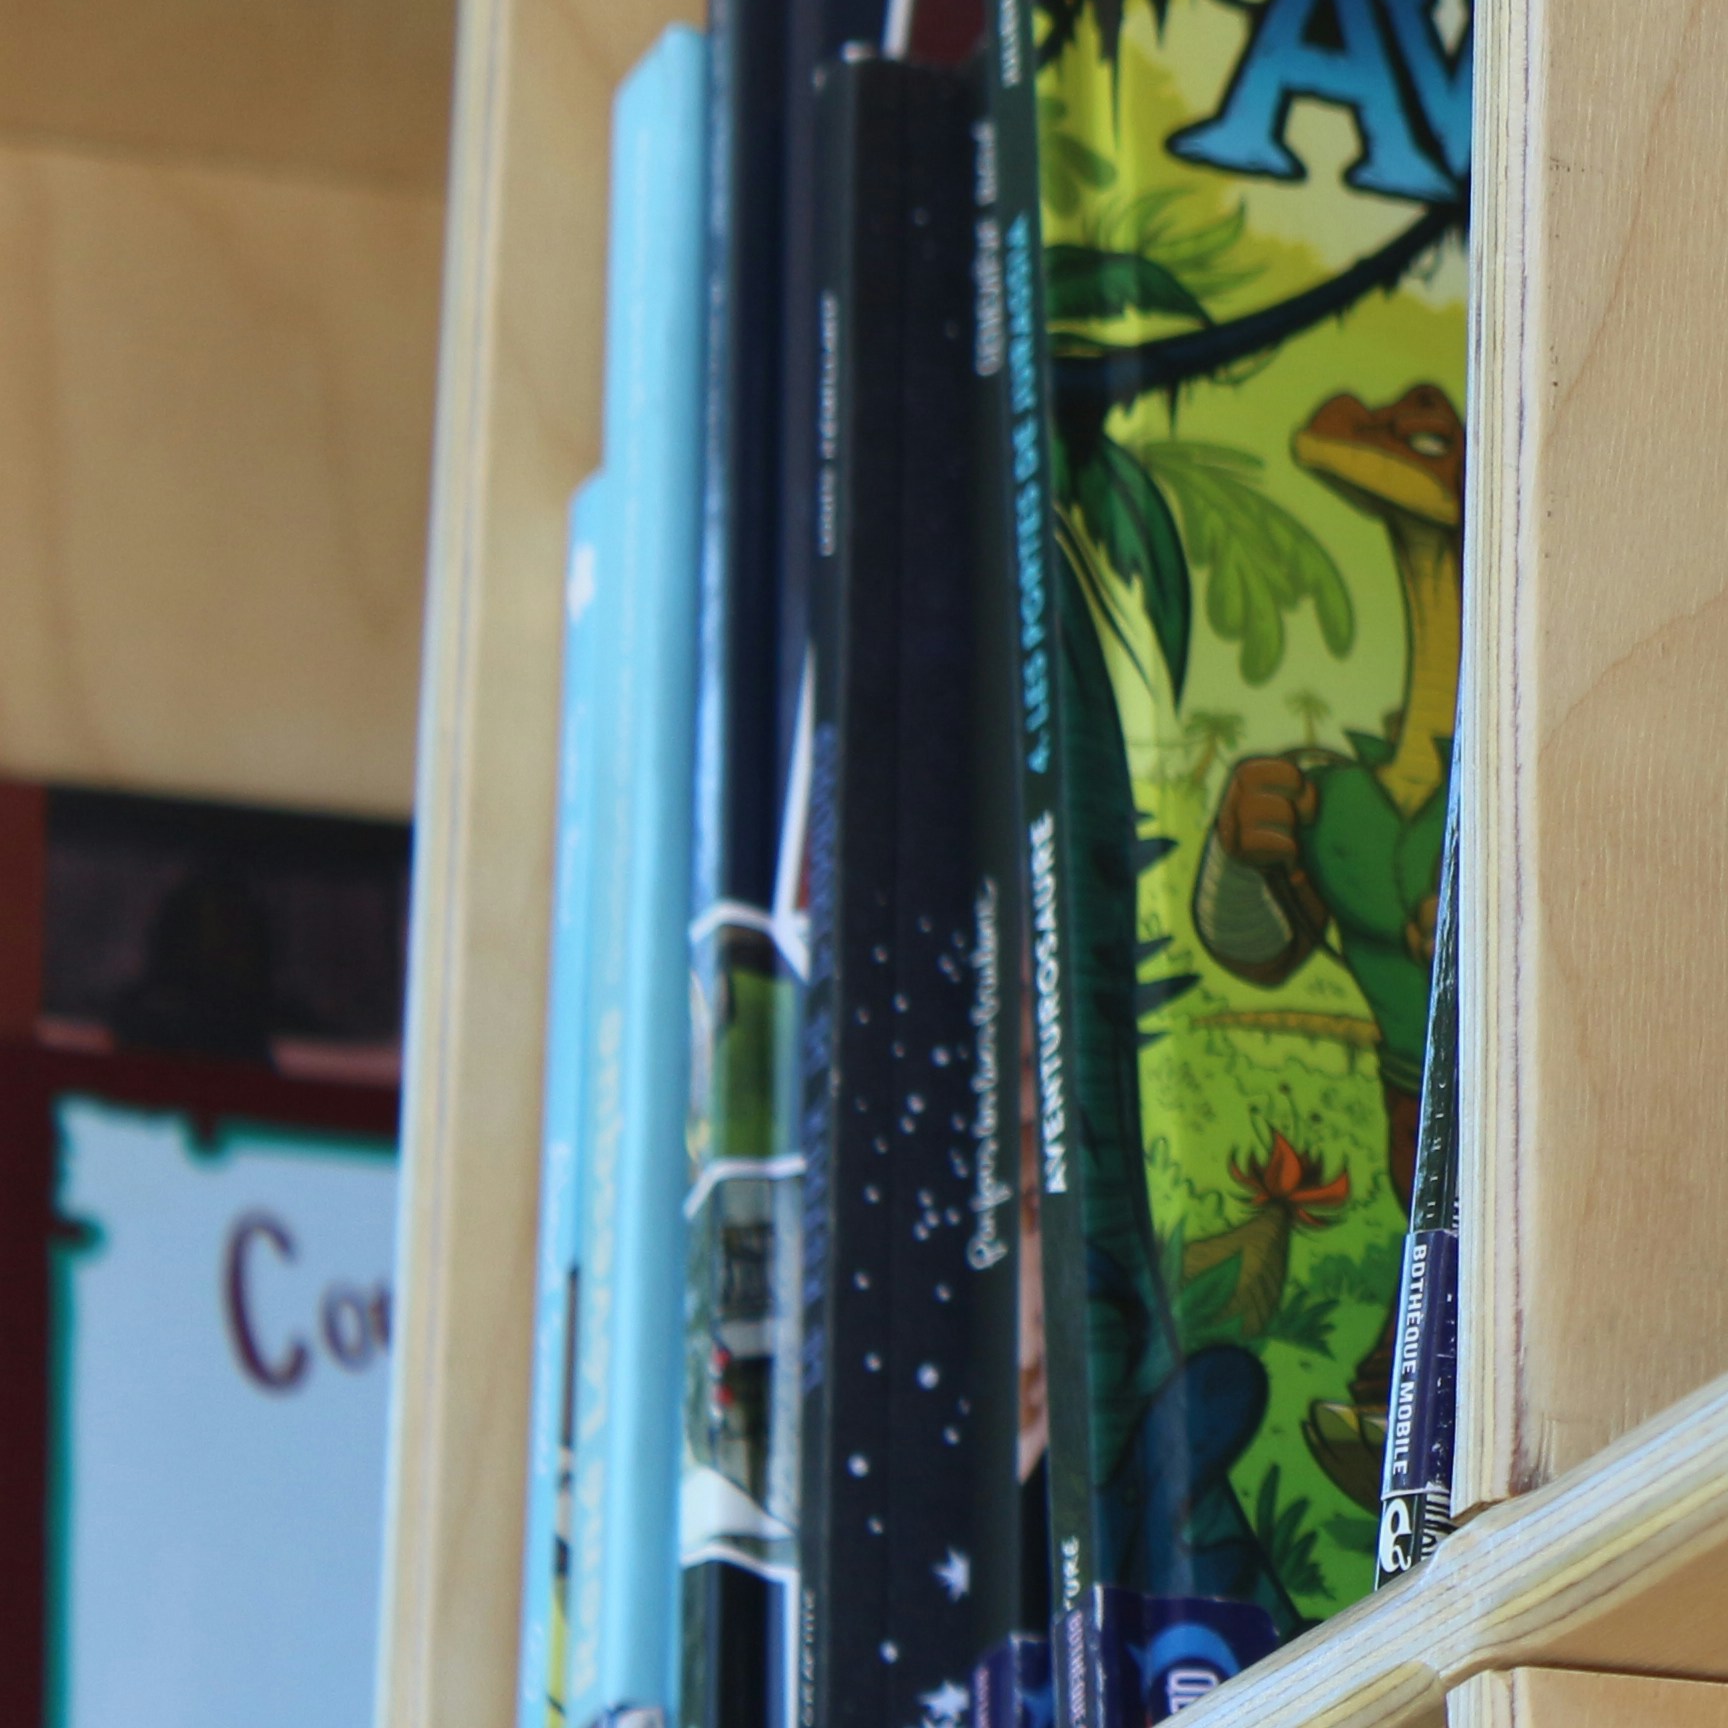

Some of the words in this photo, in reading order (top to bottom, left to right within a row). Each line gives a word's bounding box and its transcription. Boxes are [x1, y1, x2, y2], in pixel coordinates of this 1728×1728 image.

[1029, 809, 1067, 1194] AVENTUROSAURE
[1401, 1244, 1427, 1375] BDTHÈQUE
[1392, 1380, 1415, 1476] MOBILE
